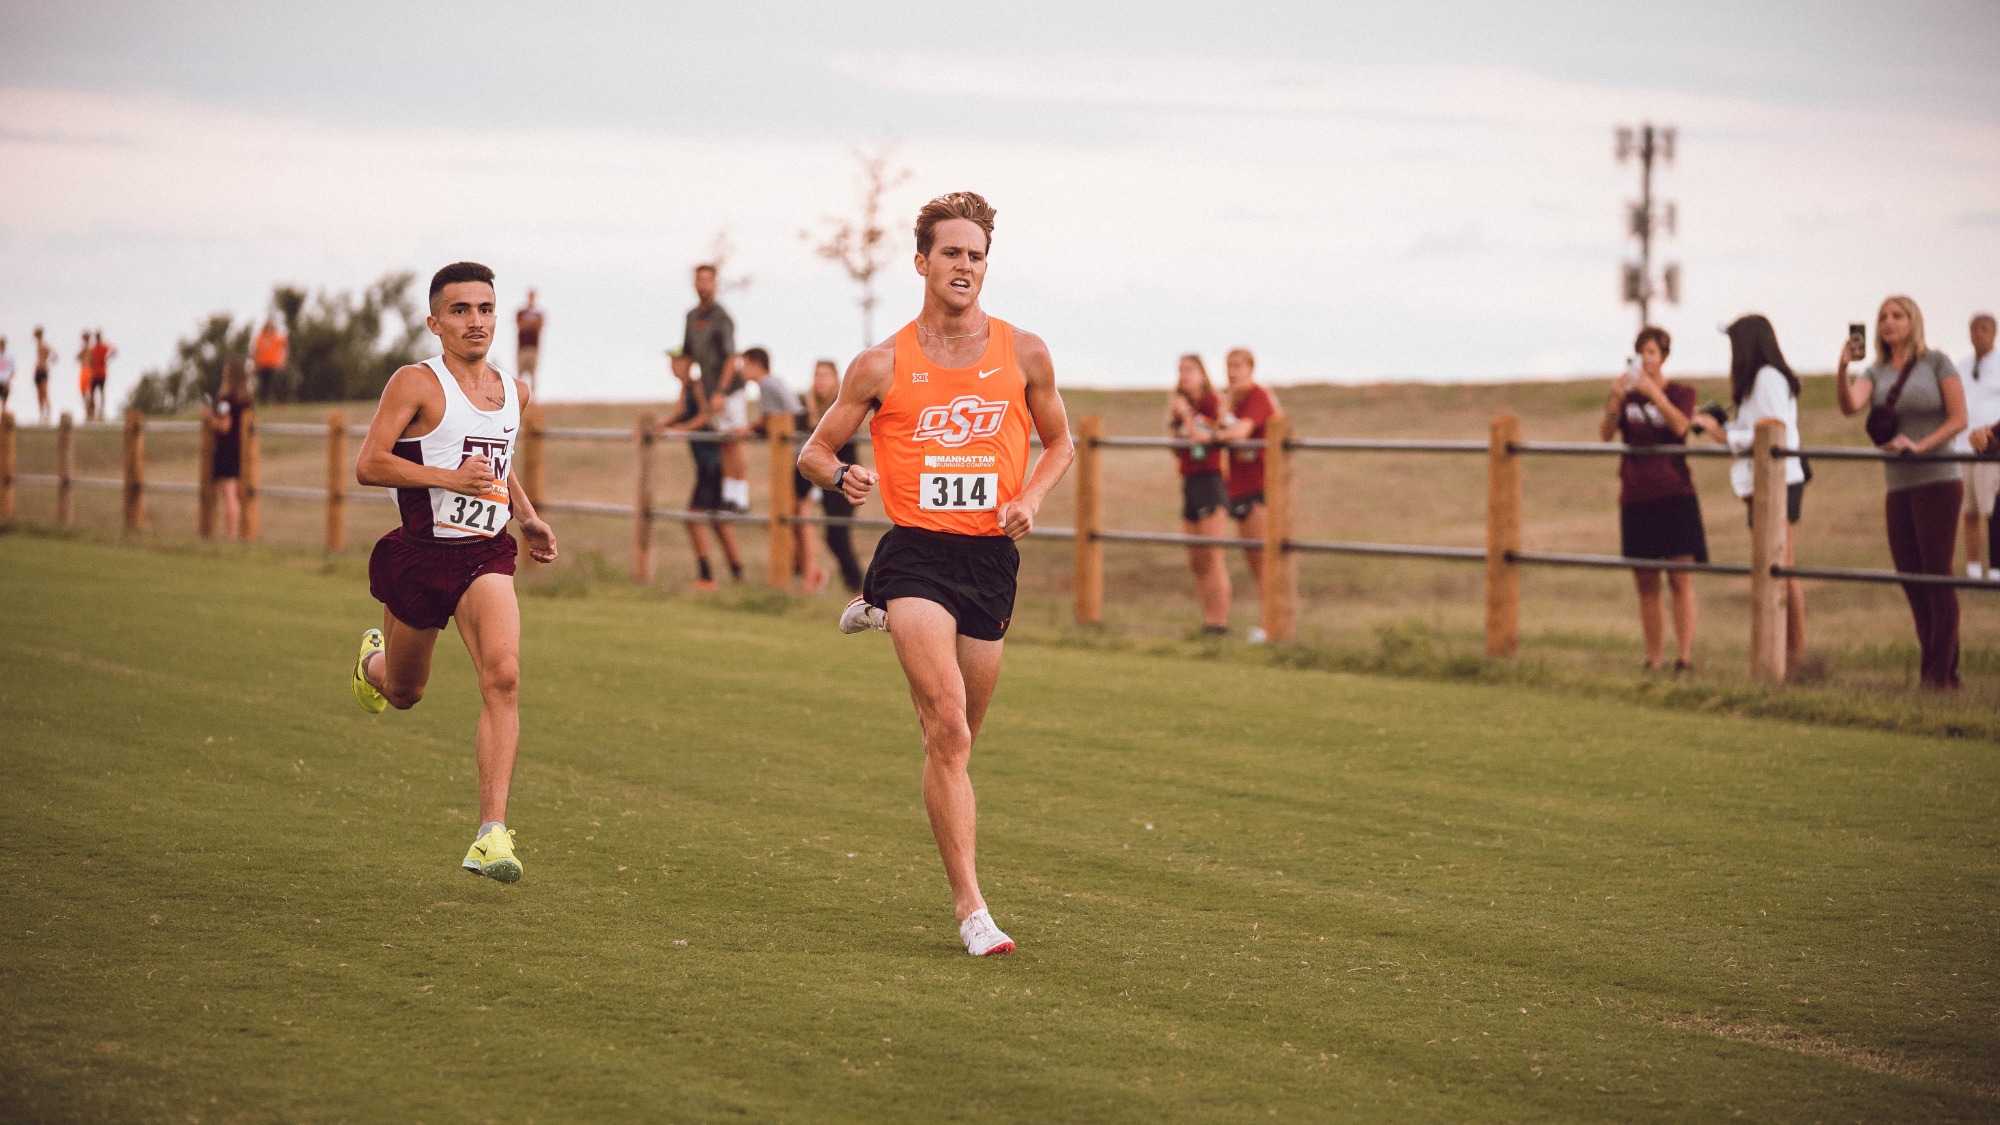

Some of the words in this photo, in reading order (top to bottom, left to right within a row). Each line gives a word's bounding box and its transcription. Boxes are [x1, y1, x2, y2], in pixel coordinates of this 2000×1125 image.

[913, 396, 1008, 446] OSU
[932, 477, 987, 506] 314
[450, 496, 496, 531] 321
